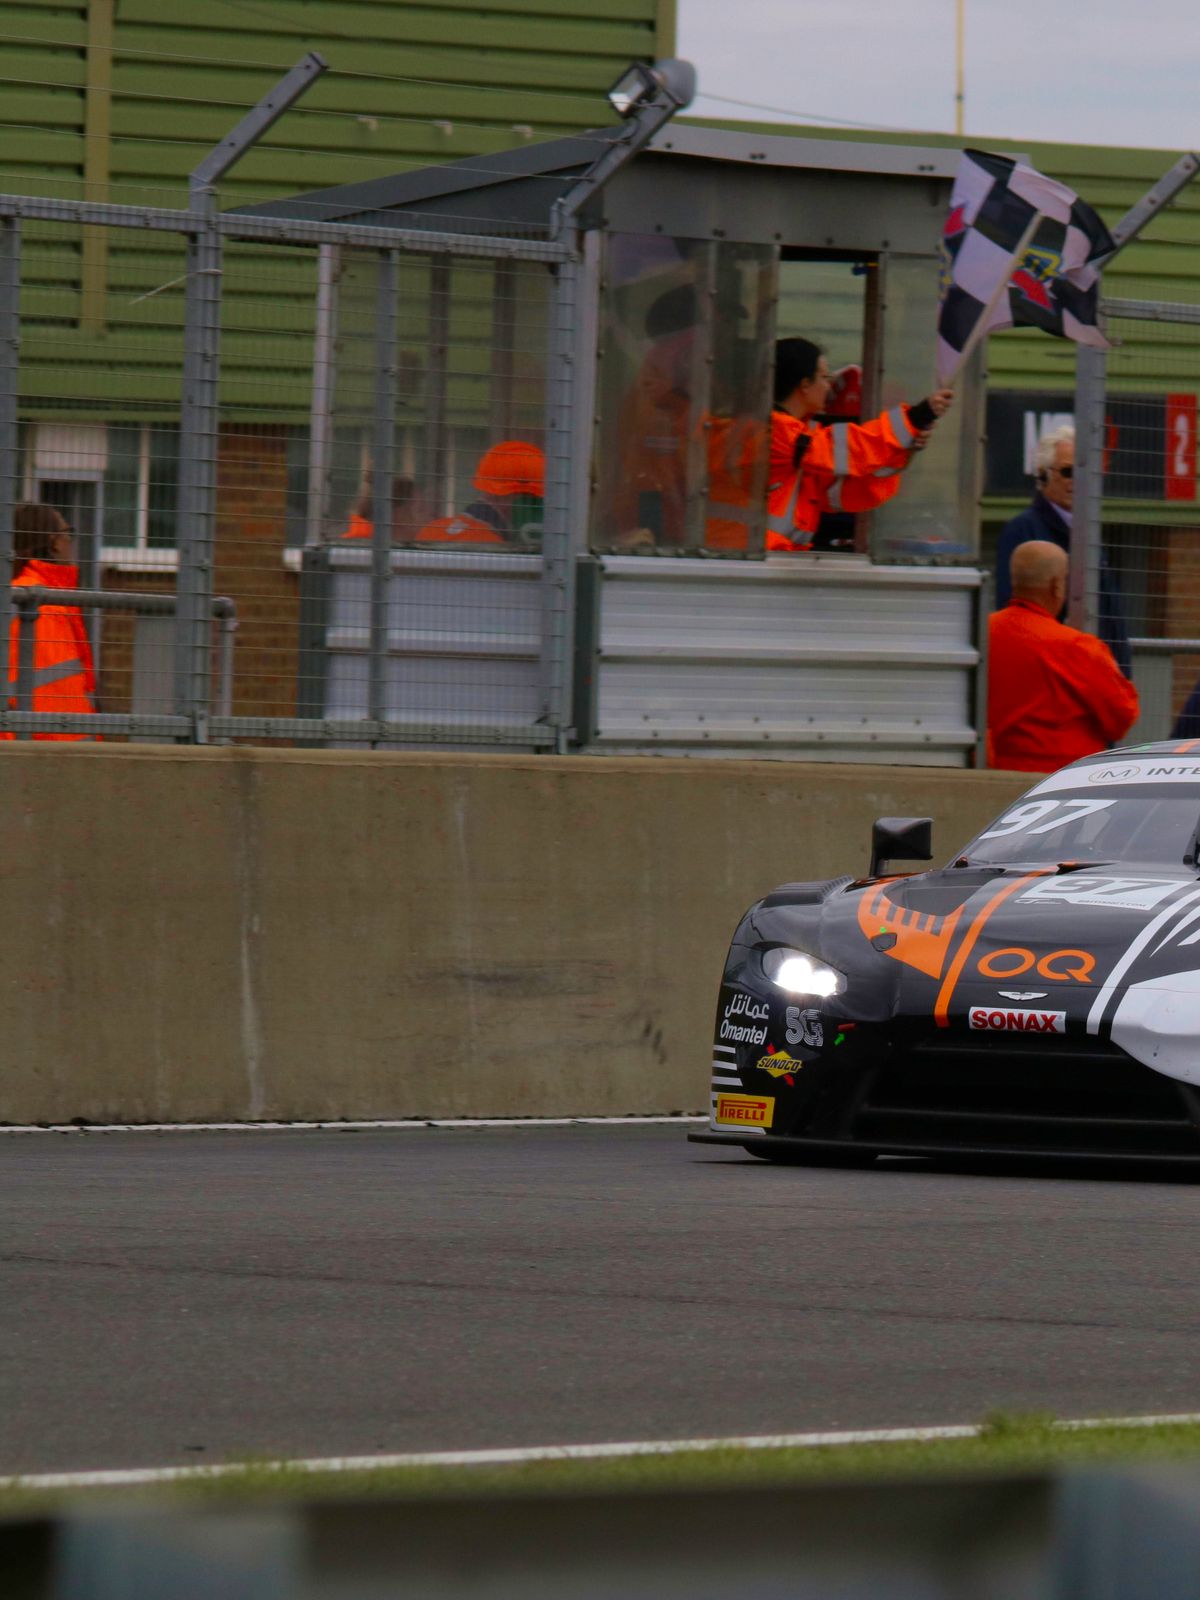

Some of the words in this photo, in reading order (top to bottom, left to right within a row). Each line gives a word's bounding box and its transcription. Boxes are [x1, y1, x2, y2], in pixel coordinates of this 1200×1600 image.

[978, 798, 1120, 840] 97
[1039, 878, 1177, 896] 97
[977, 947, 1097, 983] OQ
[720, 1019, 769, 1046] Omantel
[785, 1006, 824, 1047] 5G
[971, 1009, 1058, 1034] SONAX
[758, 1057, 801, 1072] SUNOCO
[719, 1099, 767, 1121] PIRELLI
